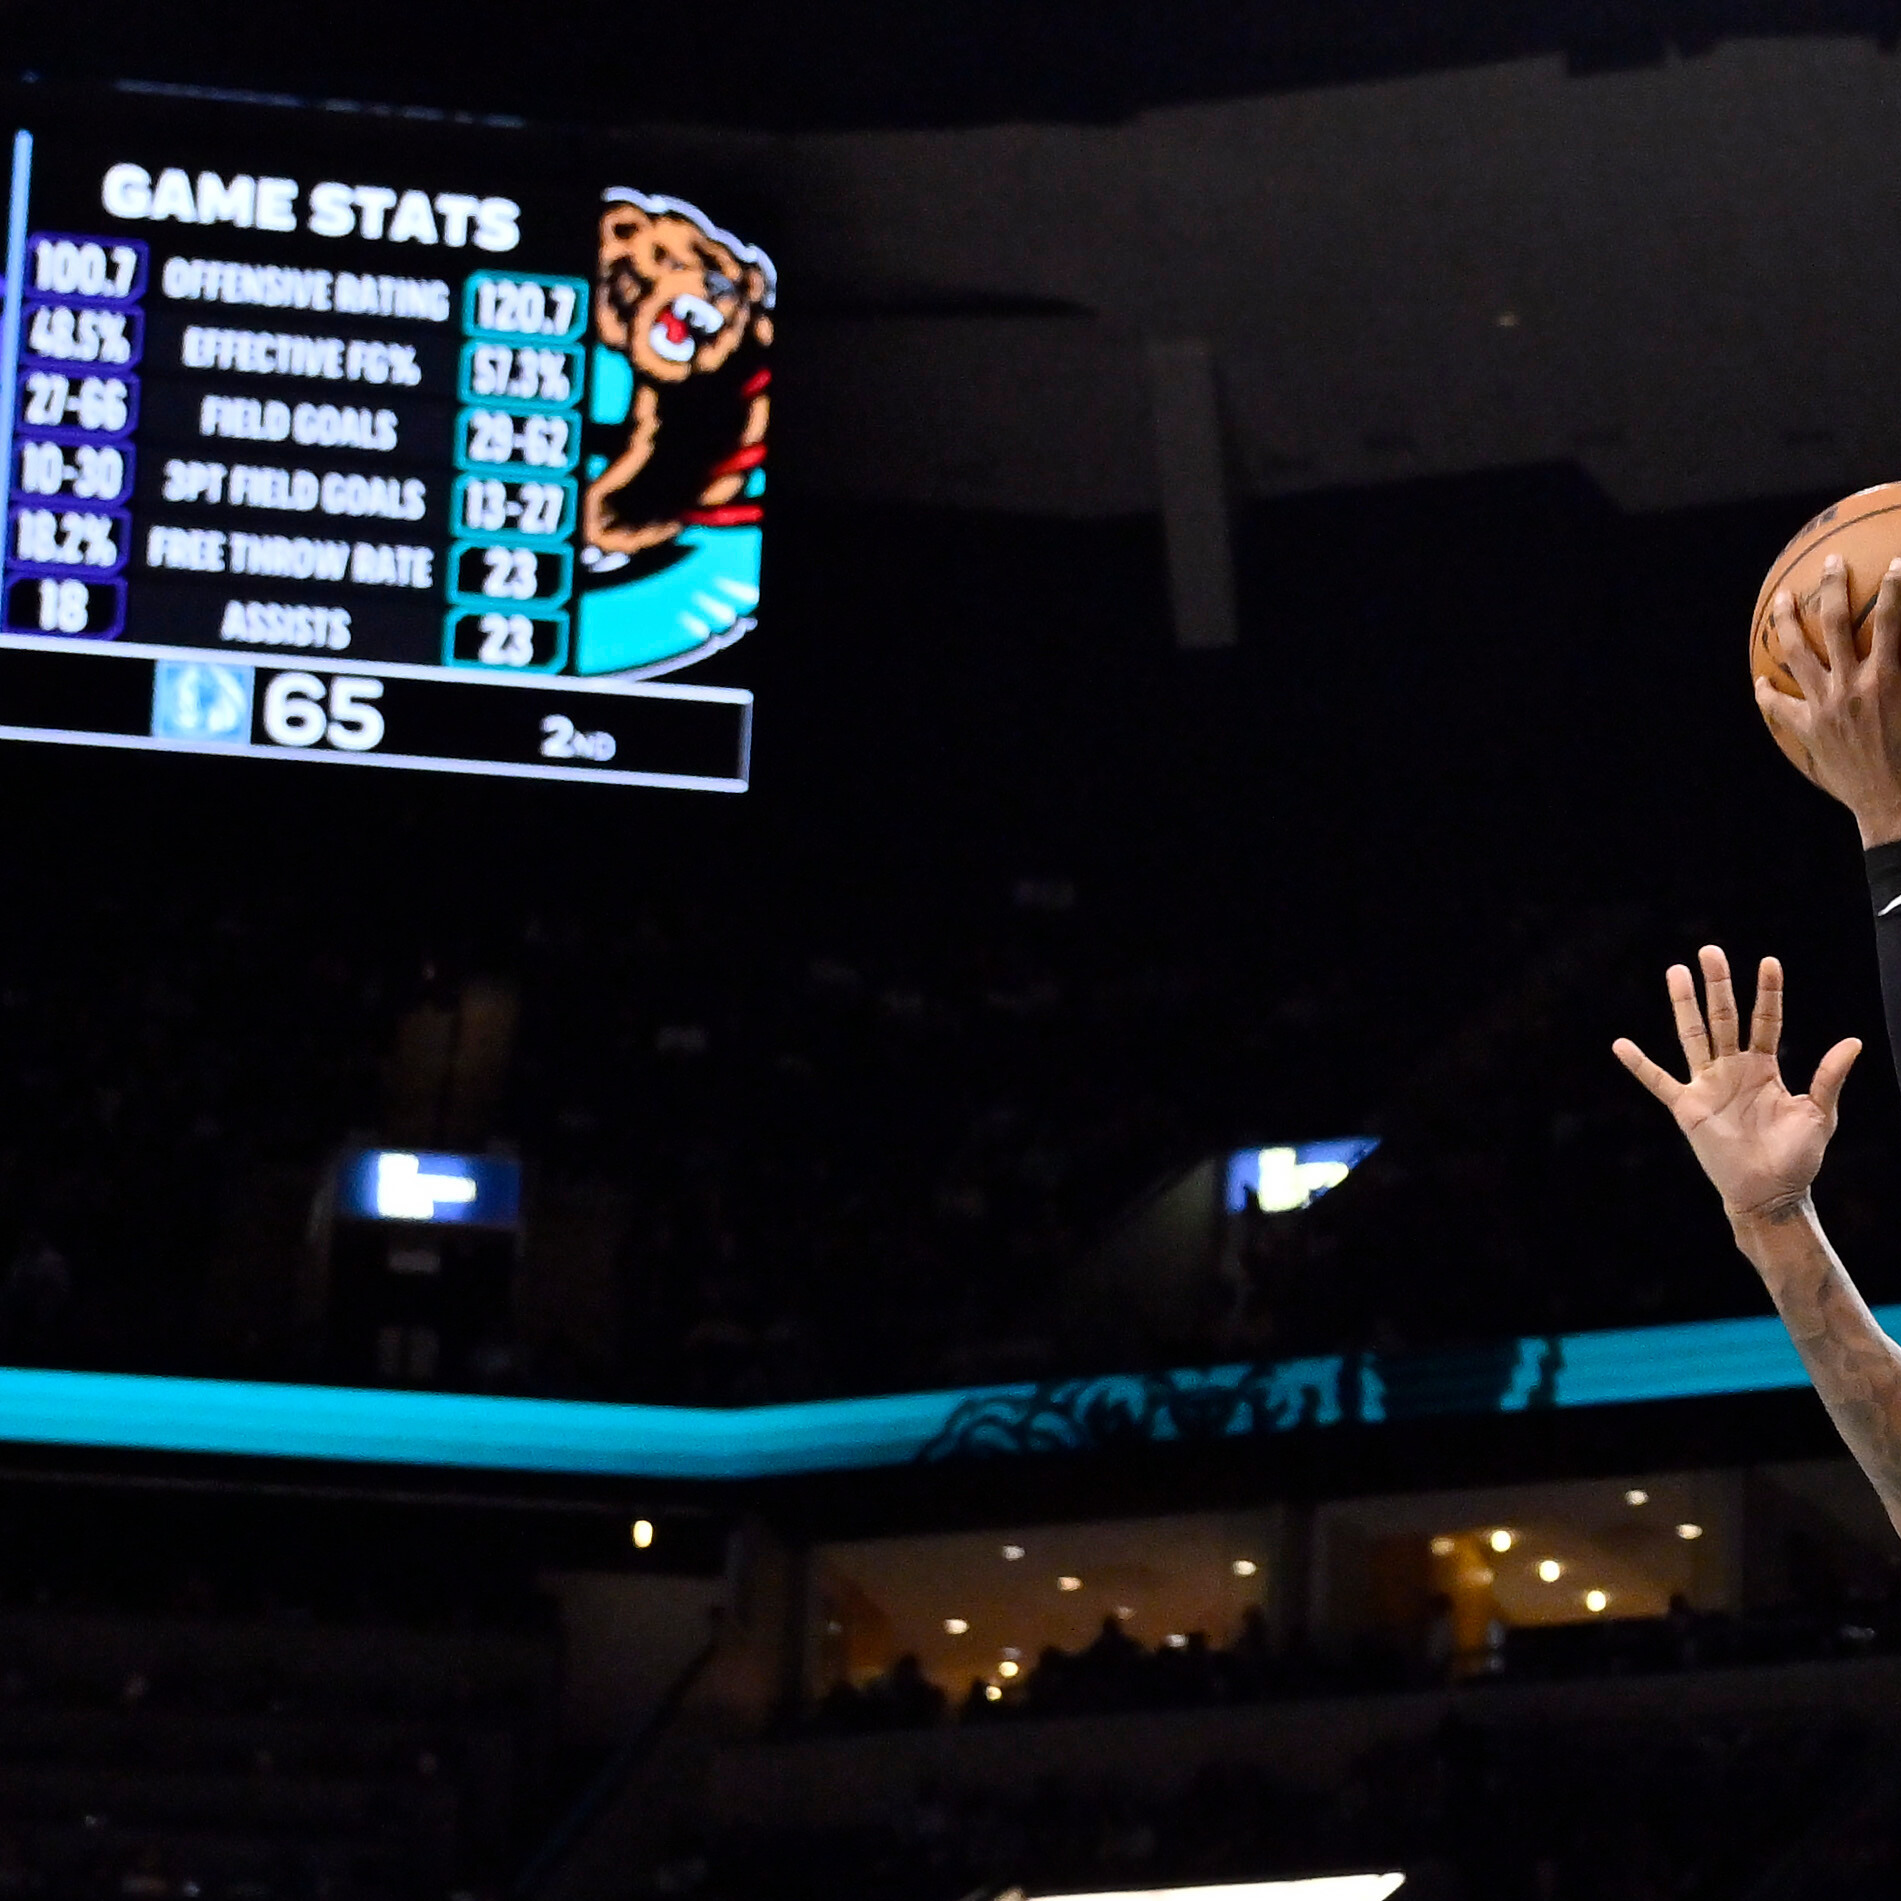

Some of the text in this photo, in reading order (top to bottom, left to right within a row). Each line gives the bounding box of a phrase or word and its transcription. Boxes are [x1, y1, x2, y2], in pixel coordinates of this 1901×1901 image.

[102, 162, 520, 252] GAME STATS
[34, 240, 136, 297] 100.7
[162, 256, 449, 321] OFFENSIVE RATING
[475, 278, 575, 330] 120.7
[30, 307, 130, 363] 48.5%
[182, 326, 421, 388] EFFECTIVE FG%
[24, 374, 128, 430] 27-66
[472, 349, 572, 399] 57.3%
[201, 396, 398, 451] FIELD GOALS
[469, 414, 569, 463] 29-62
[22, 444, 123, 500] 10-30
[162, 459, 426, 521] 3PT FIELD GOALS
[466, 482, 564, 536] 13-27
[16, 511, 118, 568] 18.2%
[147, 527, 434, 590] FREE THROW RATE
[481, 549, 538, 600] 23
[39, 579, 89, 633] 18
[220, 601, 352, 650] ASSISTS
[478, 615, 535, 668] 23
[262, 672, 385, 752] 65
[540, 715, 617, 762] 2ND
